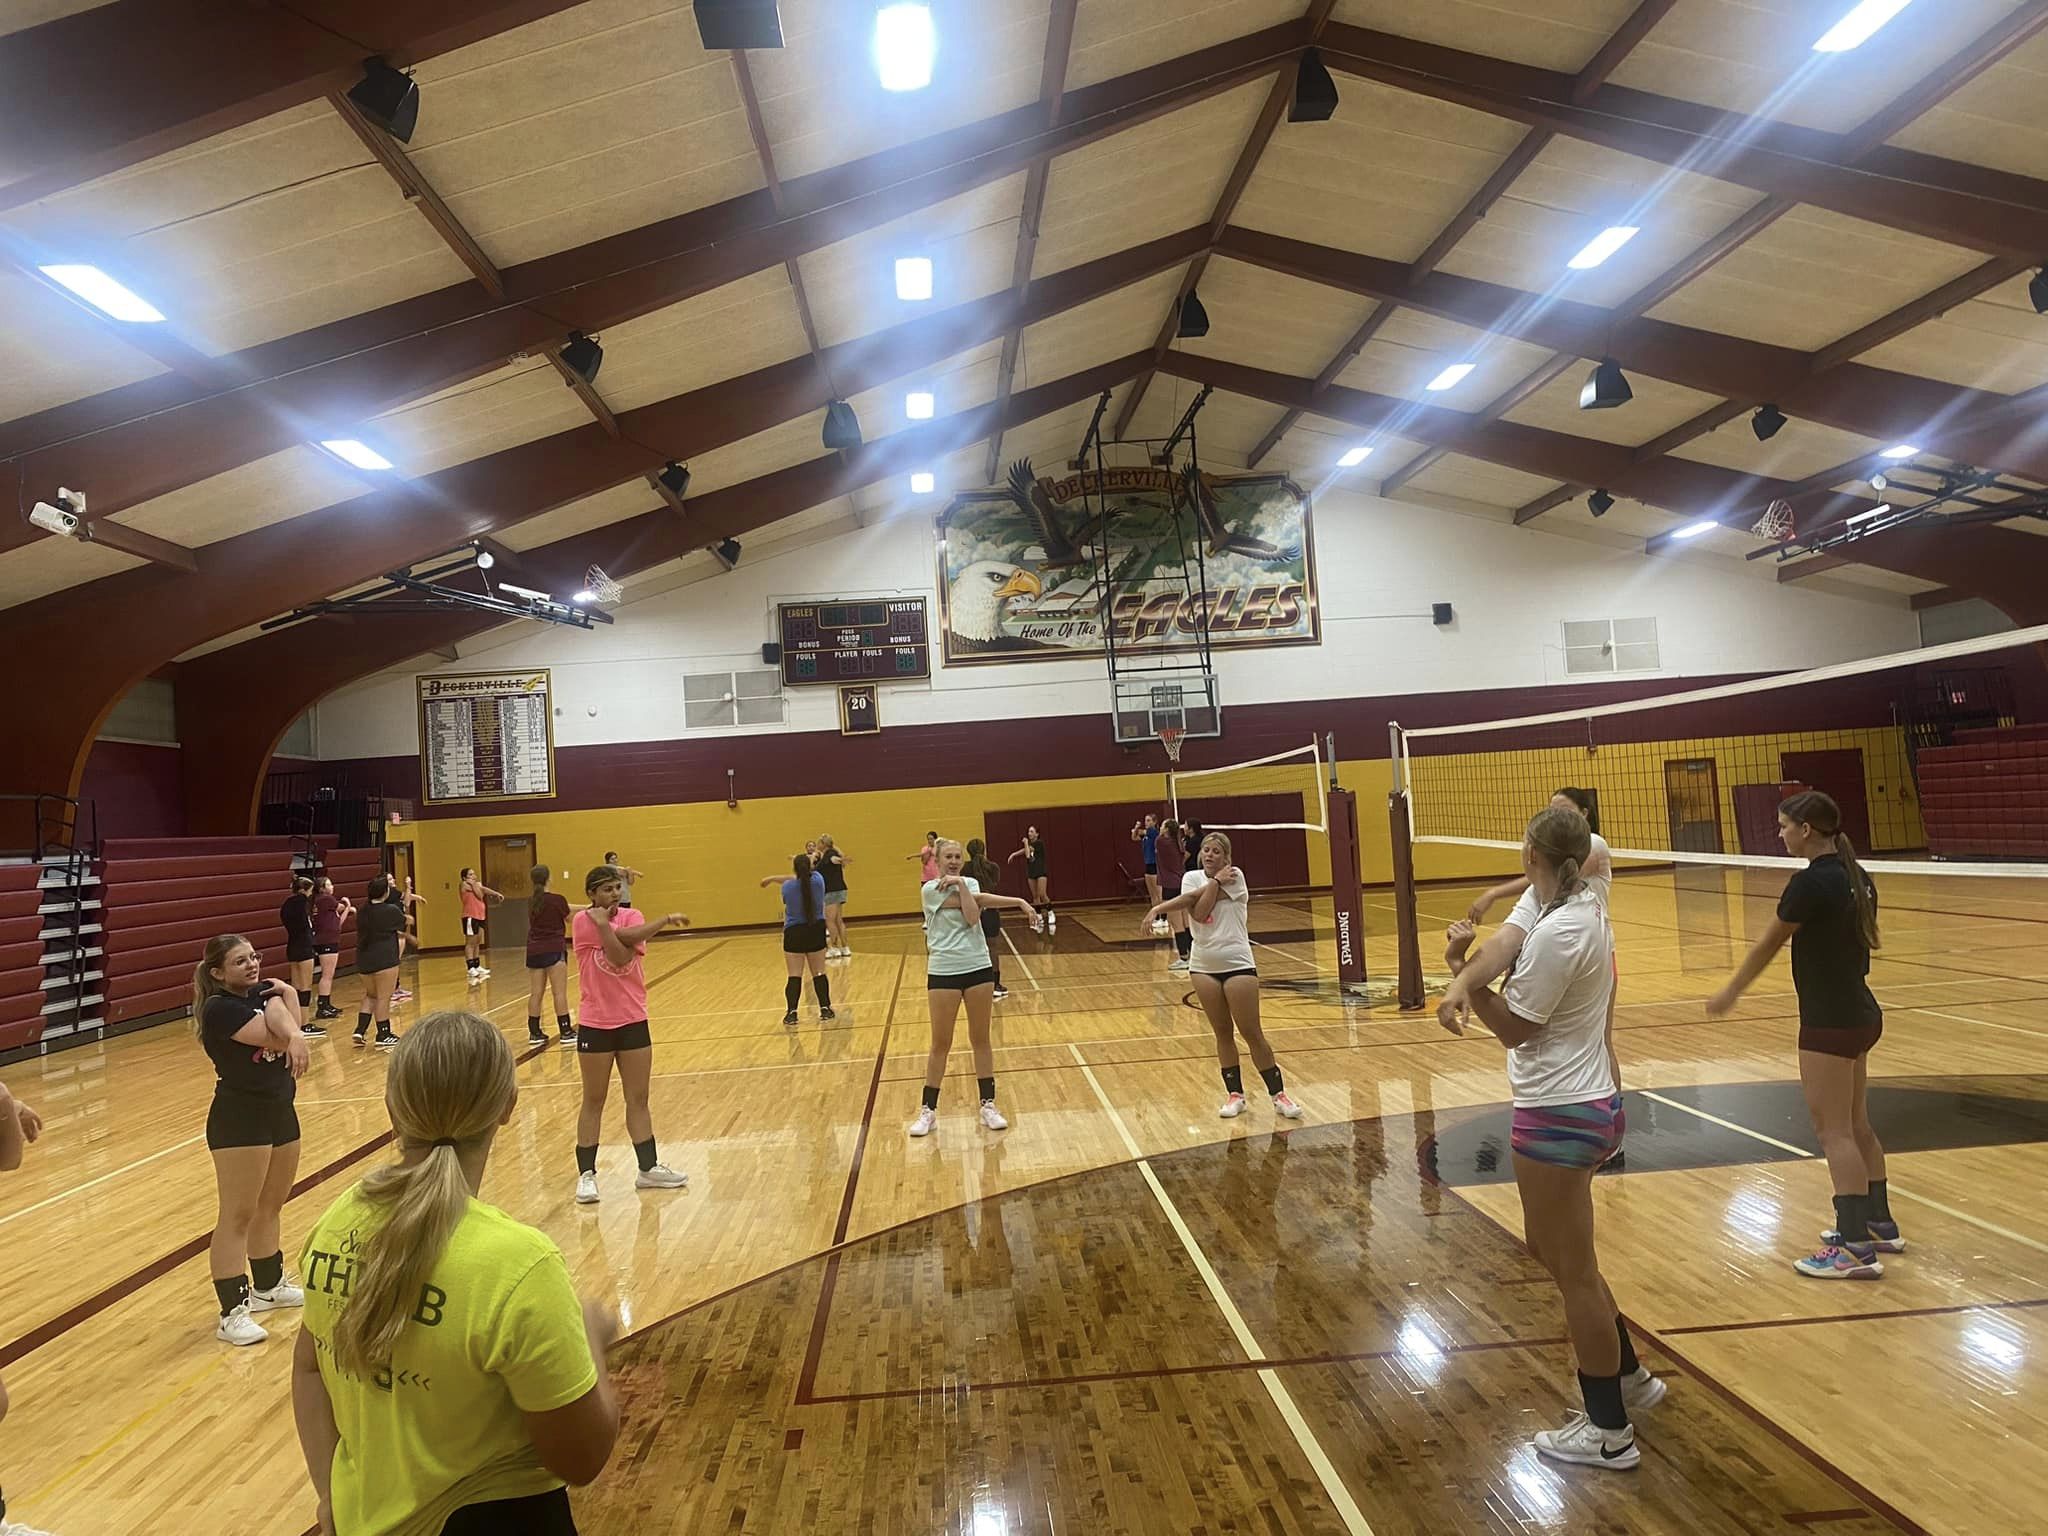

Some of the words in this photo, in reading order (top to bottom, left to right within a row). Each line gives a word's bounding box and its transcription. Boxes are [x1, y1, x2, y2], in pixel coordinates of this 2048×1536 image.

[889, 602, 922, 612] VISITOR
[787, 608, 814, 618] EAGLES
[1021, 624, 1053, 638] Home
[1058, 622, 1075, 638] Of
[1077, 621, 1097, 636] The
[1099, 585, 1304, 642] EAGLES
[862, 649, 882, 657] FOULS
[851, 697, 867, 710] 20
[1338, 911, 1353, 965] SPALDING
